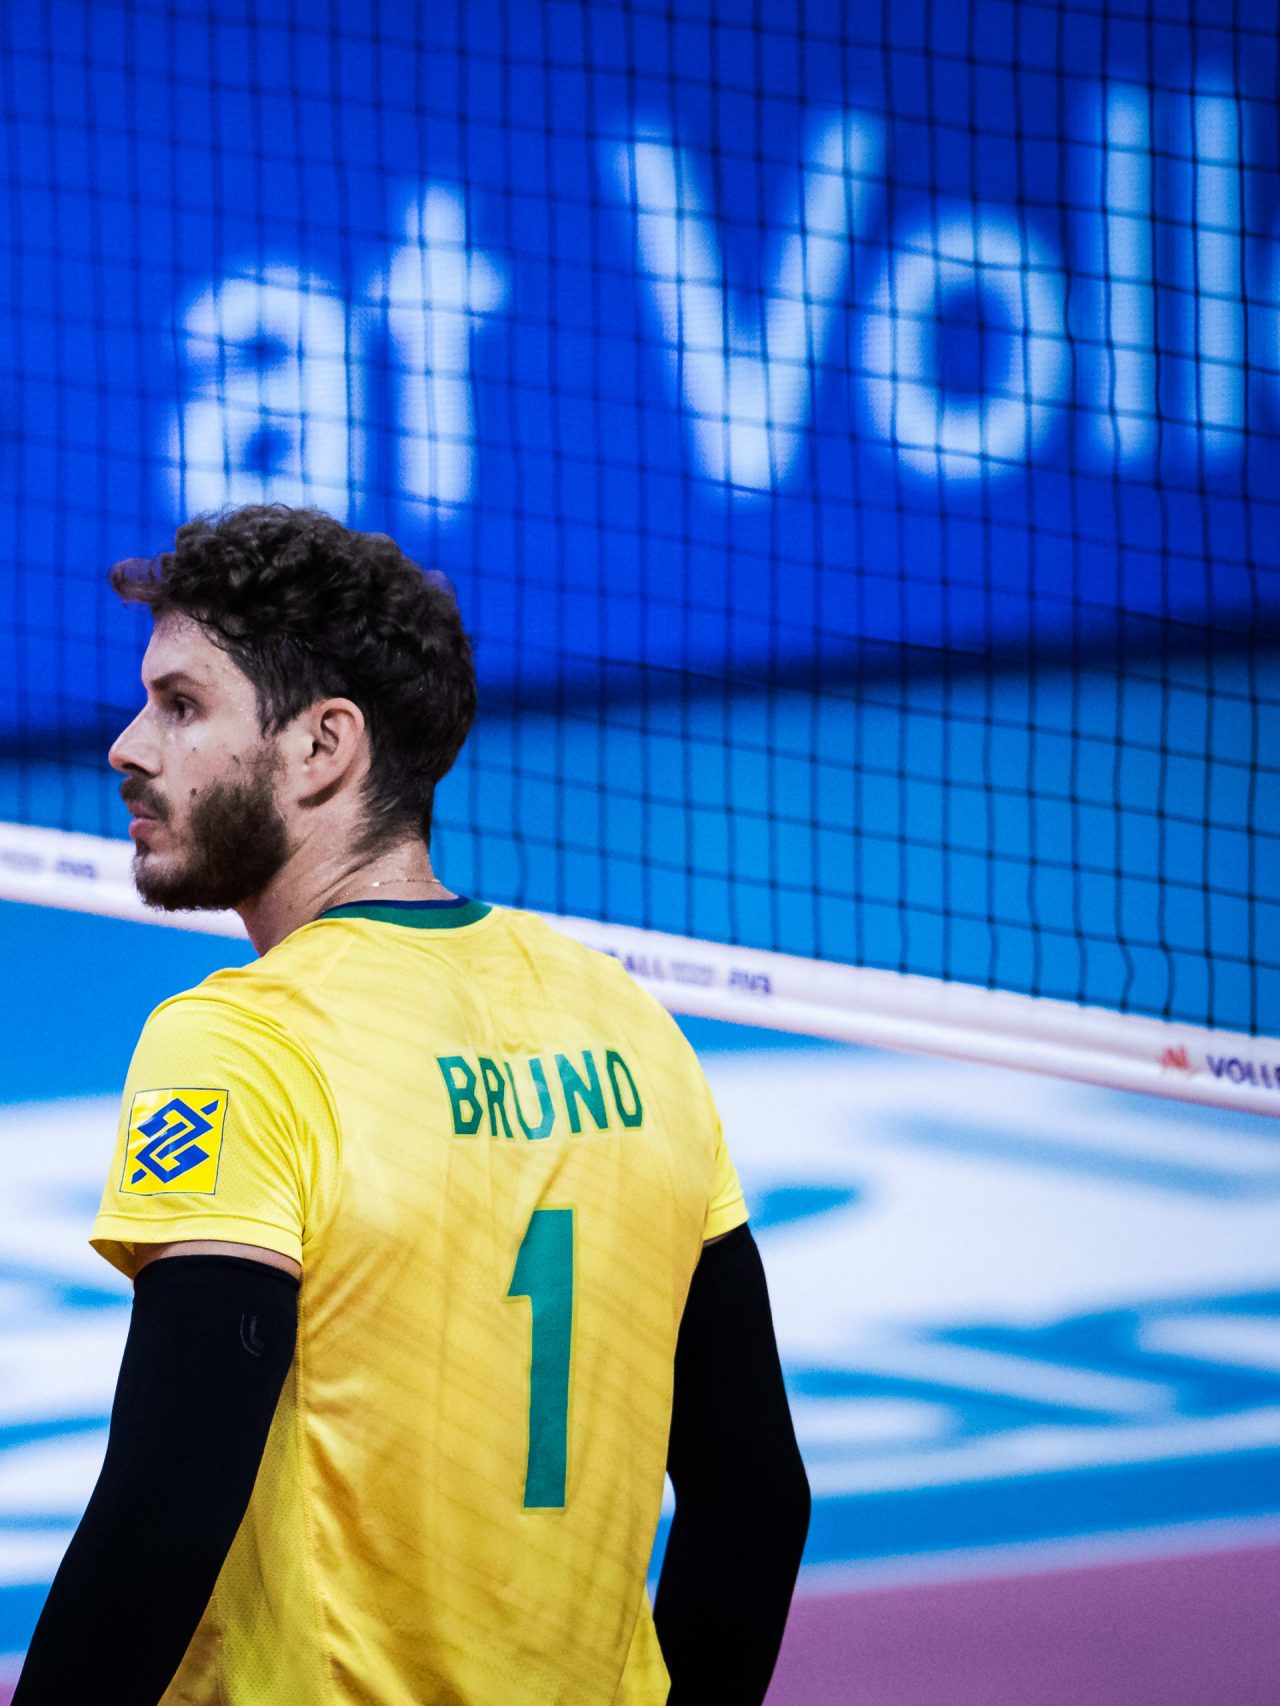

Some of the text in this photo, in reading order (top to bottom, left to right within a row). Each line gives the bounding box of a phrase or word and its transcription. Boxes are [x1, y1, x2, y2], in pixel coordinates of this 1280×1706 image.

[168, 176, 510, 524] at
[616, 78, 1280, 498] Voll
[434, 1049, 643, 1141] BRUNO
[506, 1208, 574, 1508] 1
